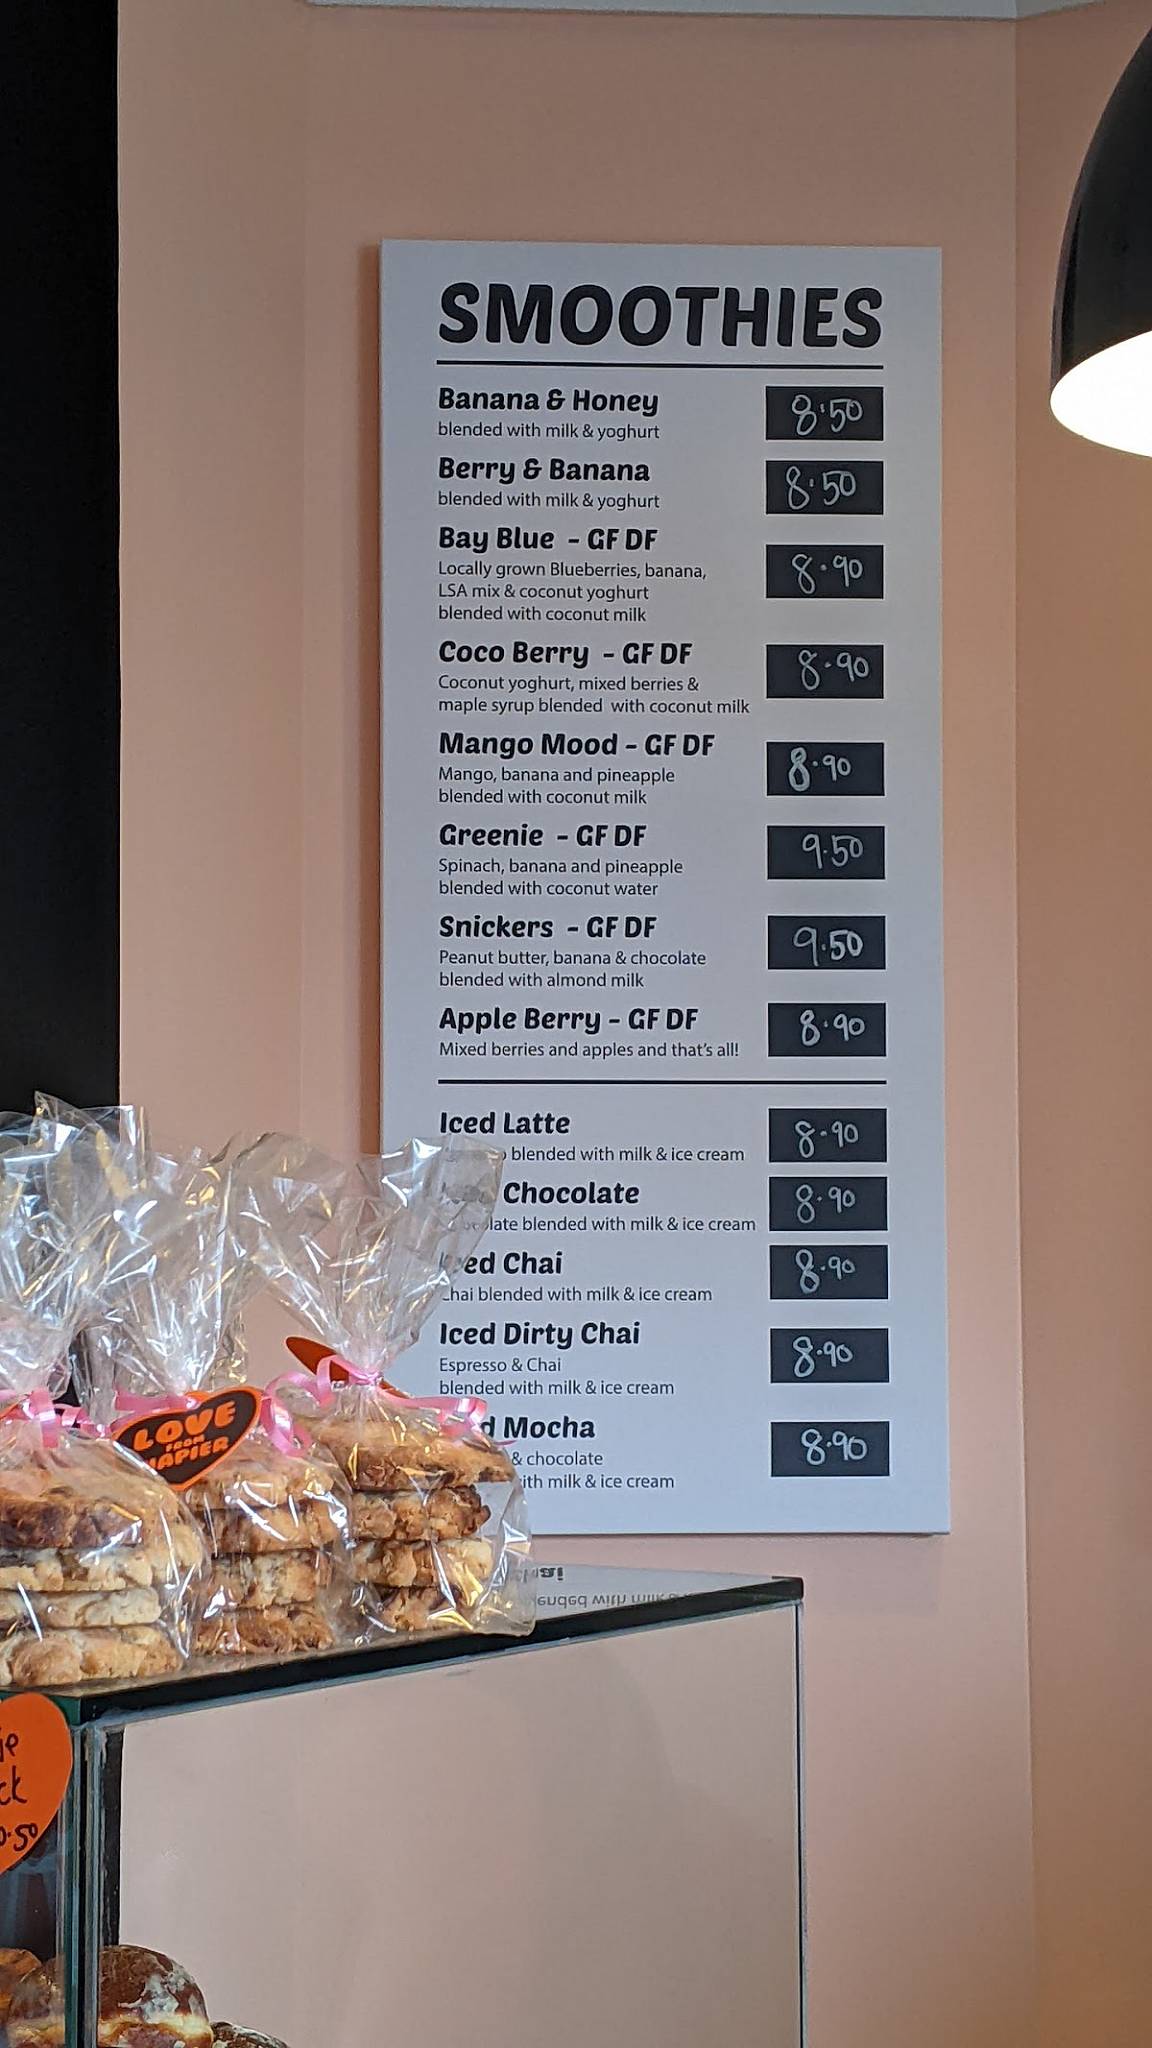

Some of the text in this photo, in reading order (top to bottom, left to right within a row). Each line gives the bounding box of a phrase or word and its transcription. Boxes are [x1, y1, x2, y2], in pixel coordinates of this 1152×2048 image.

[439, 282, 883, 349] SMOOTHIES
[439, 388, 658, 417] Banana & Honey
[438, 421, 659, 441] blended with milk & yoghurt
[439, 457, 650, 485] Berry & Banana
[439, 491, 659, 511] blended with milk & yoghurt
[439, 527, 658, 553] Bay Blue GF DF
[439, 560, 706, 580] Locally grown Blueberries, banana,
[439, 583, 648, 602] LSA mix & coconut yoghurt
[439, 605, 646, 621] blended with coconut milk
[439, 641, 692, 669] Coco Berry GF DF
[439, 675, 698, 693] Coconut yoghurt, mixed berries &
[439, 697, 750, 715] maple syrup blended with coconut milk
[440, 732, 715, 759] Mango Mood GF DF
[439, 766, 674, 786] Mango, banana and pineapple
[439, 788, 646, 804] blended with coconut milk
[440, 824, 646, 846] Greenie GF DF
[439, 858, 682, 877] Spinach, banana and pineapple
[440, 880, 658, 895] blended with coconut water
[440, 915, 657, 938] Snickers GF DF
[440, 950, 706, 966] Peanut butter, banana & chocolate
[440, 972, 644, 987] blended with almond milk
[439, 1007, 698, 1035] Apple Berry GF DF
[440, 1042, 486, 1056] Mixed
[492, 1041, 544, 1056] berries
[549, 1041, 577, 1056] and
[583, 1042, 633, 1060] apples
[638, 1042, 666, 1056] and
[717, 1042, 738, 1056] all!
[440, 1112, 570, 1135] Iced Latte
[512, 1146, 575, 1161] blended
[580, 1146, 614, 1161] with
[620, 1146, 652, 1161] milk
[672, 1147, 693, 1161] ice
[697, 1150, 744, 1161] cream
[504, 1181, 639, 1204] Chocolate
[523, 1216, 755, 1231] blended with milk ice cream
[504, 1251, 562, 1274] Chai
[479, 1286, 542, 1301] blended
[548, 1286, 581, 1301] with
[587, 1286, 619, 1301] milk
[639, 1287, 660, 1301] ice
[665, 1290, 712, 1301] cream
[440, 1321, 640, 1350] Iced Dirty Chai
[440, 1357, 560, 1375] Espresso & Chai
[440, 1380, 674, 1394] blended with milk ice cream
[133, 1400, 236, 1451] LOVE
[504, 1416, 595, 1438] Mocha
[511, 1450, 603, 1465] & chocolate
[520, 1474, 674, 1488] ith milk ice cream
